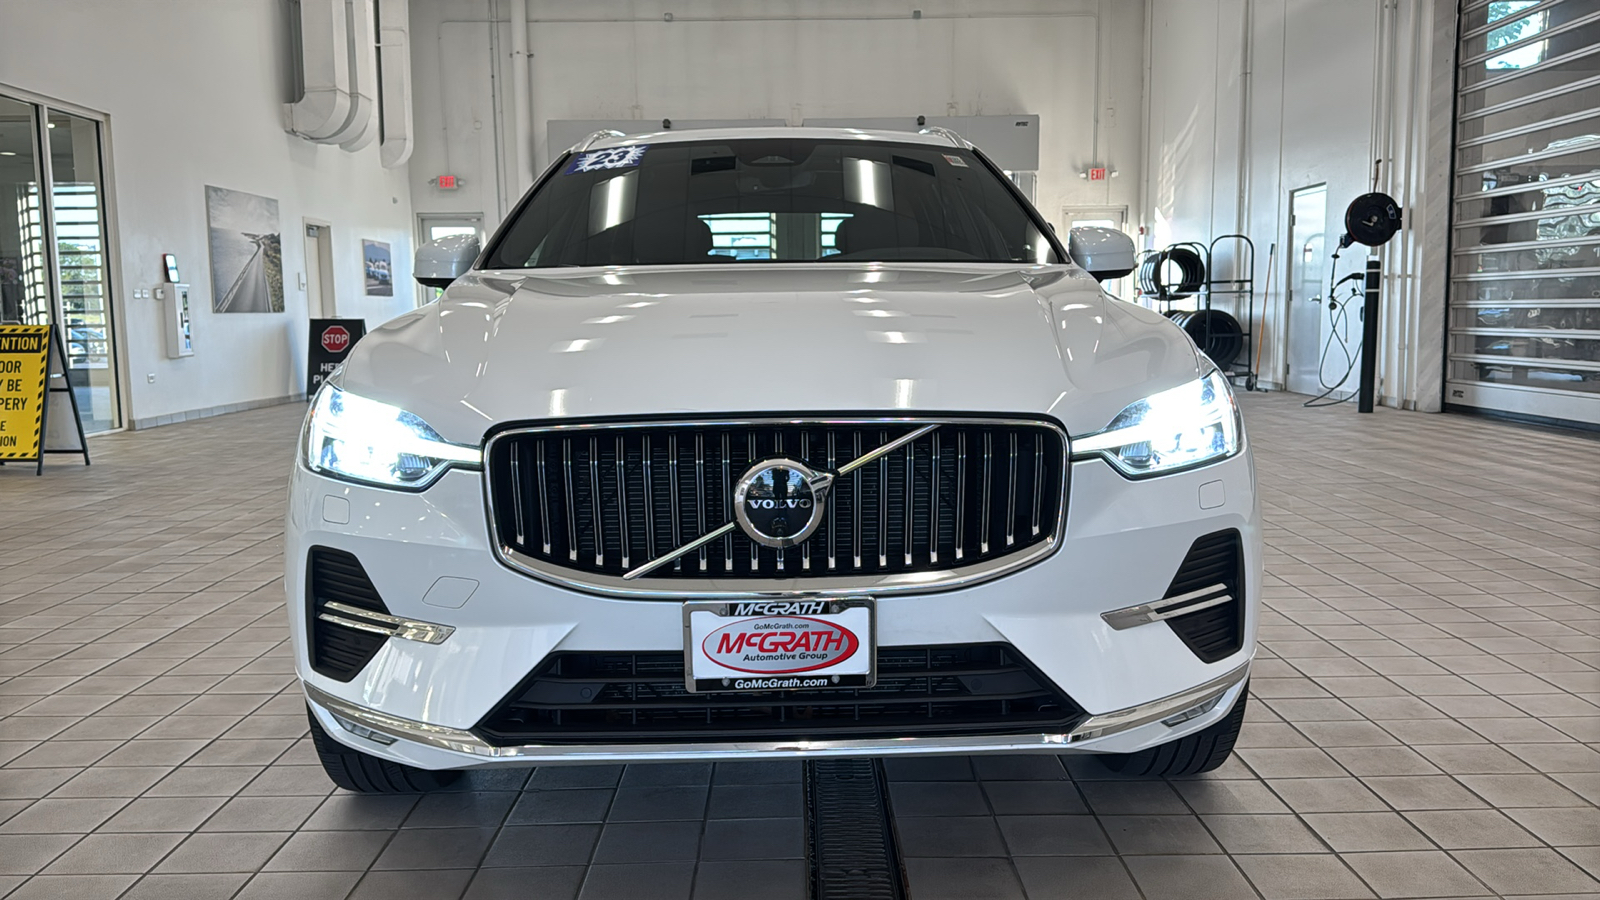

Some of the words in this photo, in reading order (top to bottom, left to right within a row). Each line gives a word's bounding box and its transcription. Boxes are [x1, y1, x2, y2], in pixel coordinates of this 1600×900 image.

[587, 150, 630, 166] 23
[1091, 168, 1105, 180] EXIT
[439, 175, 454, 188] EXIT
[0, 336, 38, 350] NTION
[323, 334, 348, 344] STOP
[7, 379, 22, 392] BE
[747, 499, 811, 509] VOLVO
[754, 621, 809, 630] GoMcGrath.com
[743, 653, 796, 662] Automotive
[798, 652, 828, 662] Group
[734, 678, 828, 690] GoMcGrath.com
